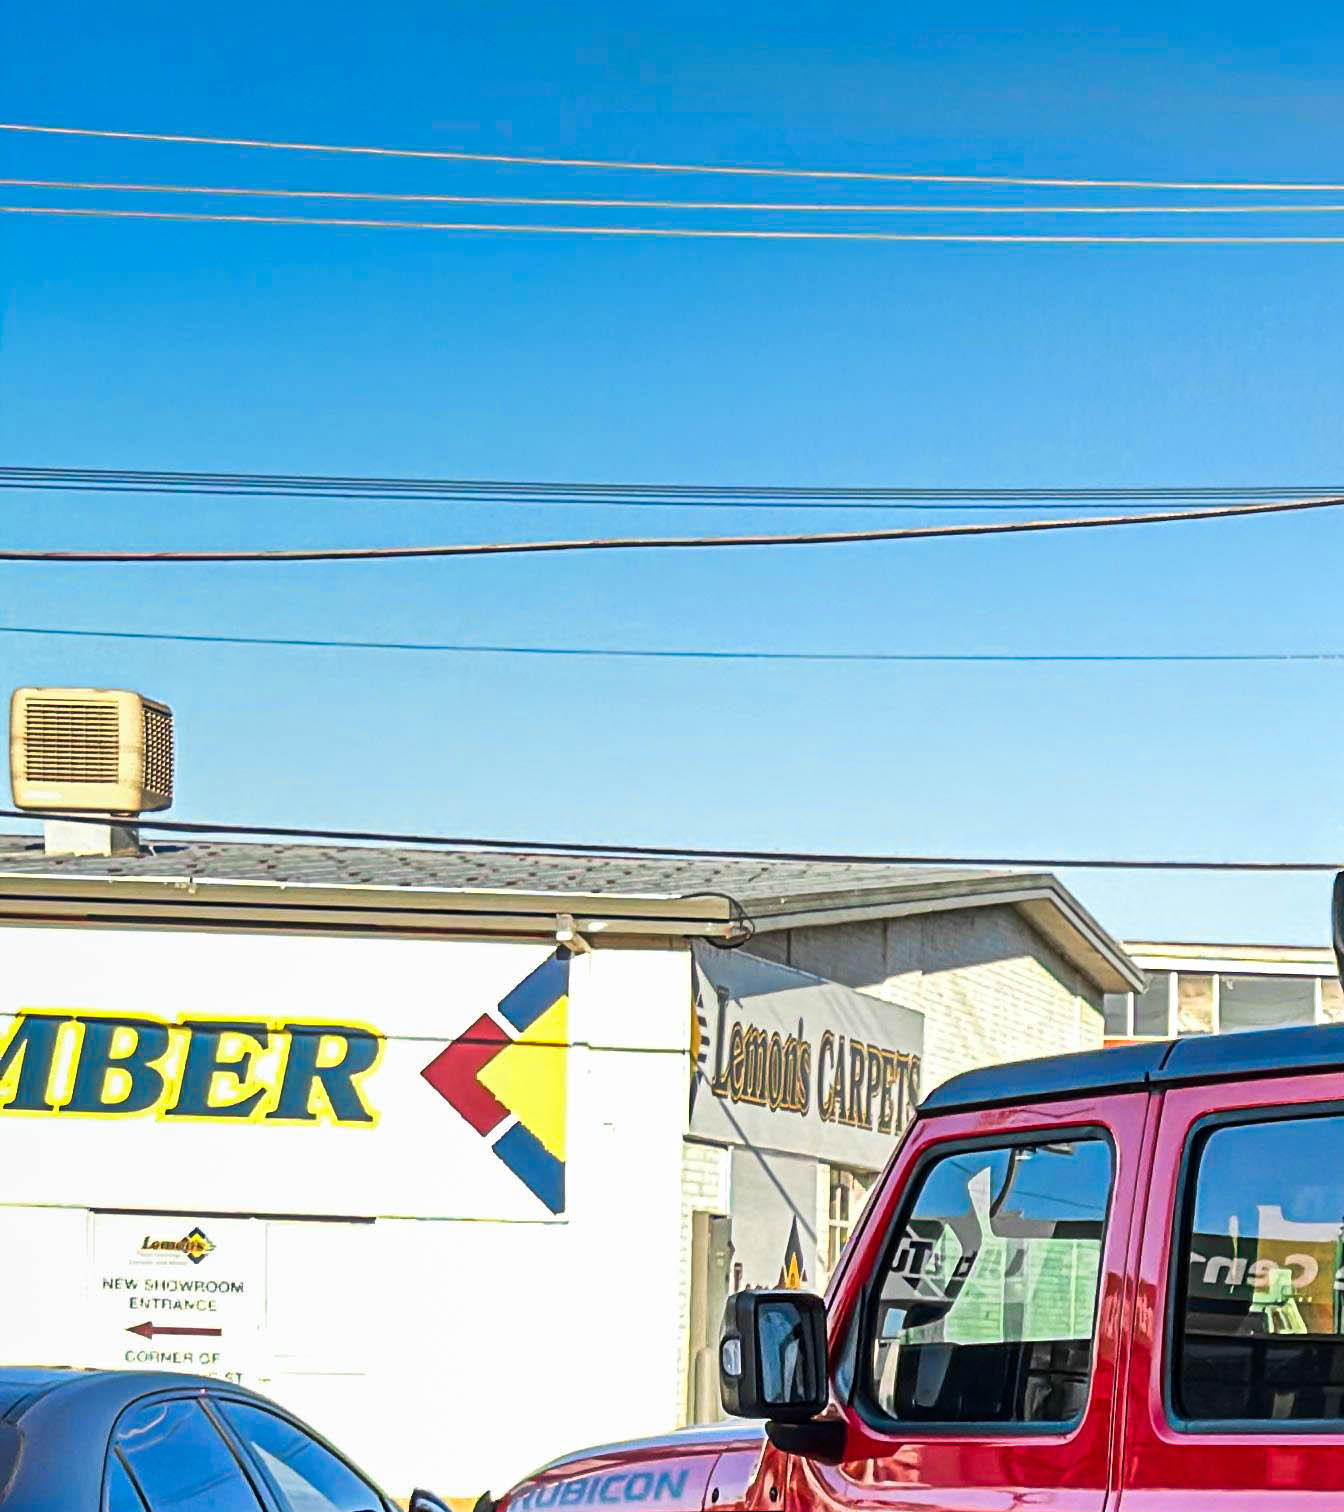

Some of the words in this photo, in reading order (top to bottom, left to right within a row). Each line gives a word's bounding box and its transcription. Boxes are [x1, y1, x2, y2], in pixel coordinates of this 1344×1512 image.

[818, 1029, 921, 1137] CARPETS
[103, 1277, 137, 1291] NEW
[144, 1278, 244, 1293] SHOWROOM
[129, 1297, 217, 1312] ENTRANCE
[125, 1350, 193, 1364] CORNER
[200, 1351, 221, 1364] OF
